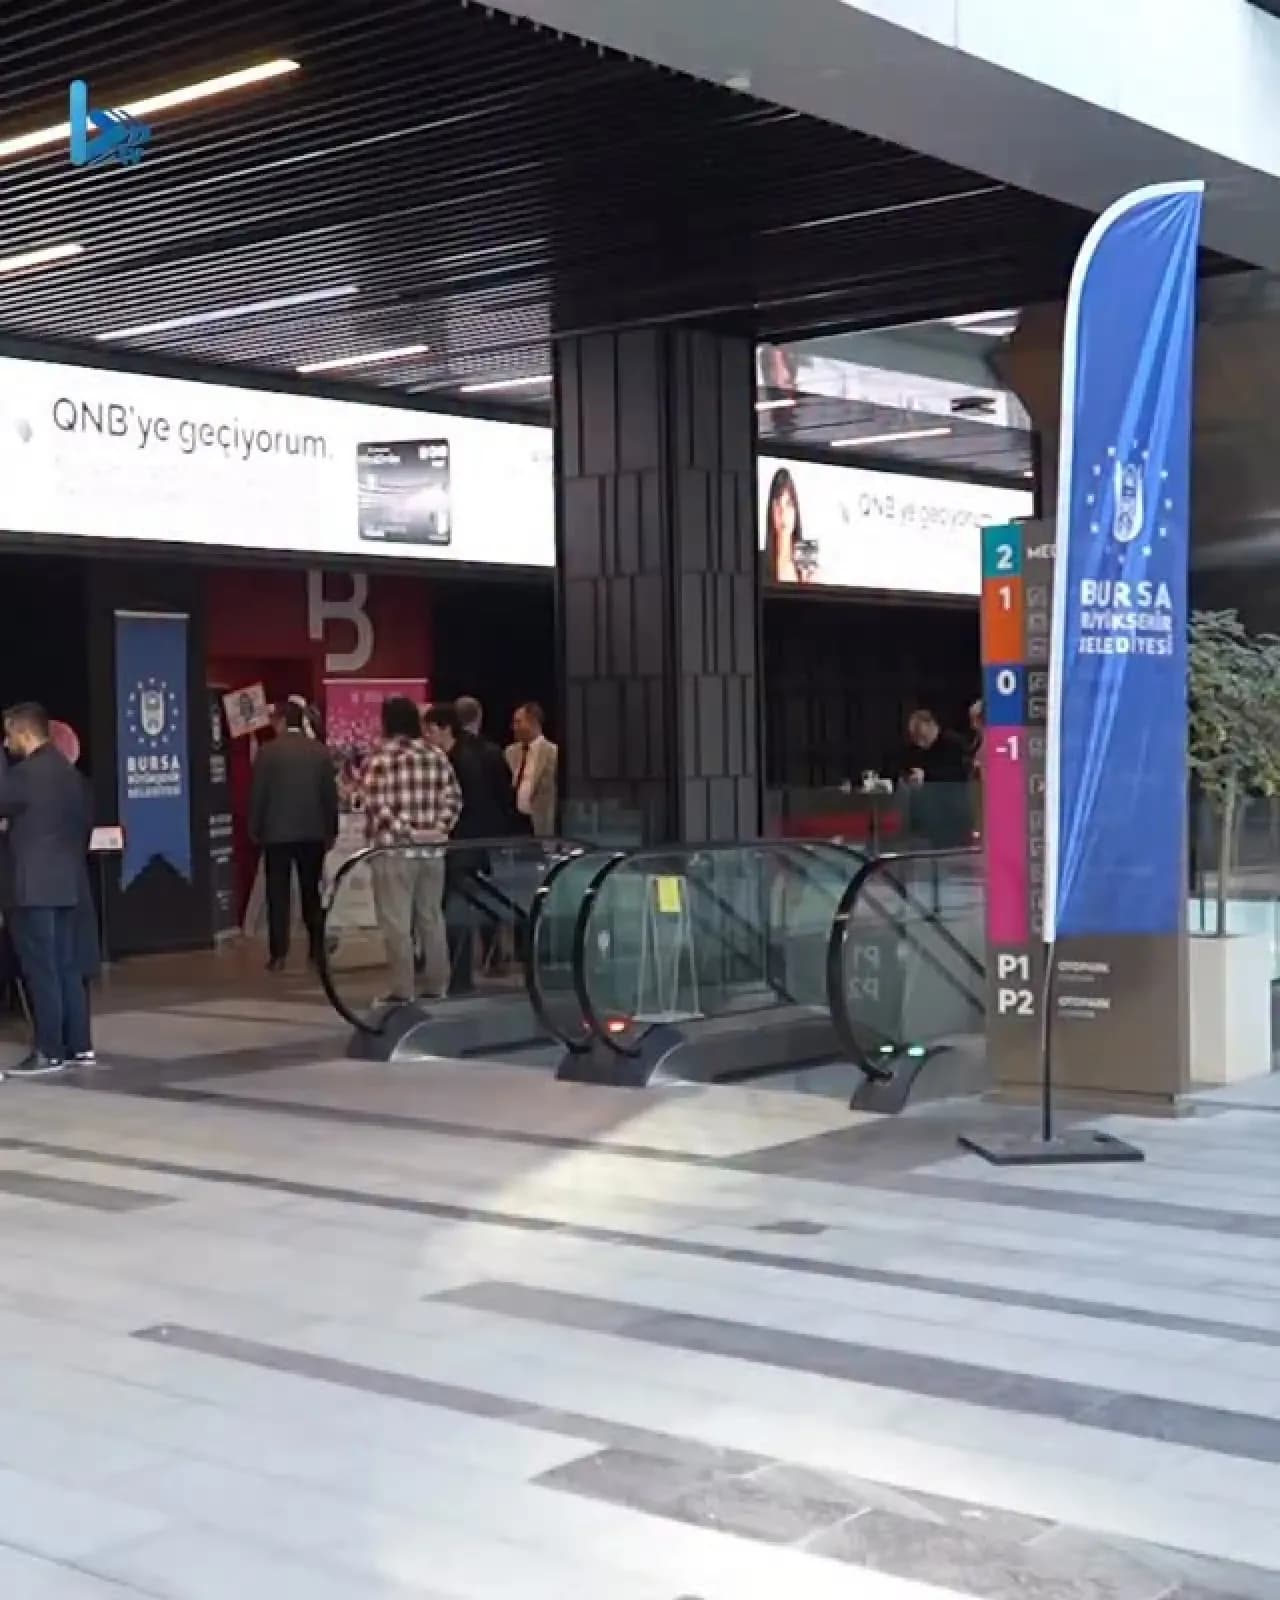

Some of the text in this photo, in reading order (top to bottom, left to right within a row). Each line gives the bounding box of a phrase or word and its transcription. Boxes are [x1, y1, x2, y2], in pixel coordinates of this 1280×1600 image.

[53, 397, 334, 461] QNB'ye geçiyorum.
[995, 543, 1014, 570] 2
[998, 585, 1012, 612] 1
[1080, 579, 1172, 609] BURSA
[995, 669, 1017, 697] 0
[995, 735, 1019, 761] -1
[127, 754, 181, 771] BURSA
[998, 953, 1030, 980] P1
[998, 987, 1035, 1016] P2
